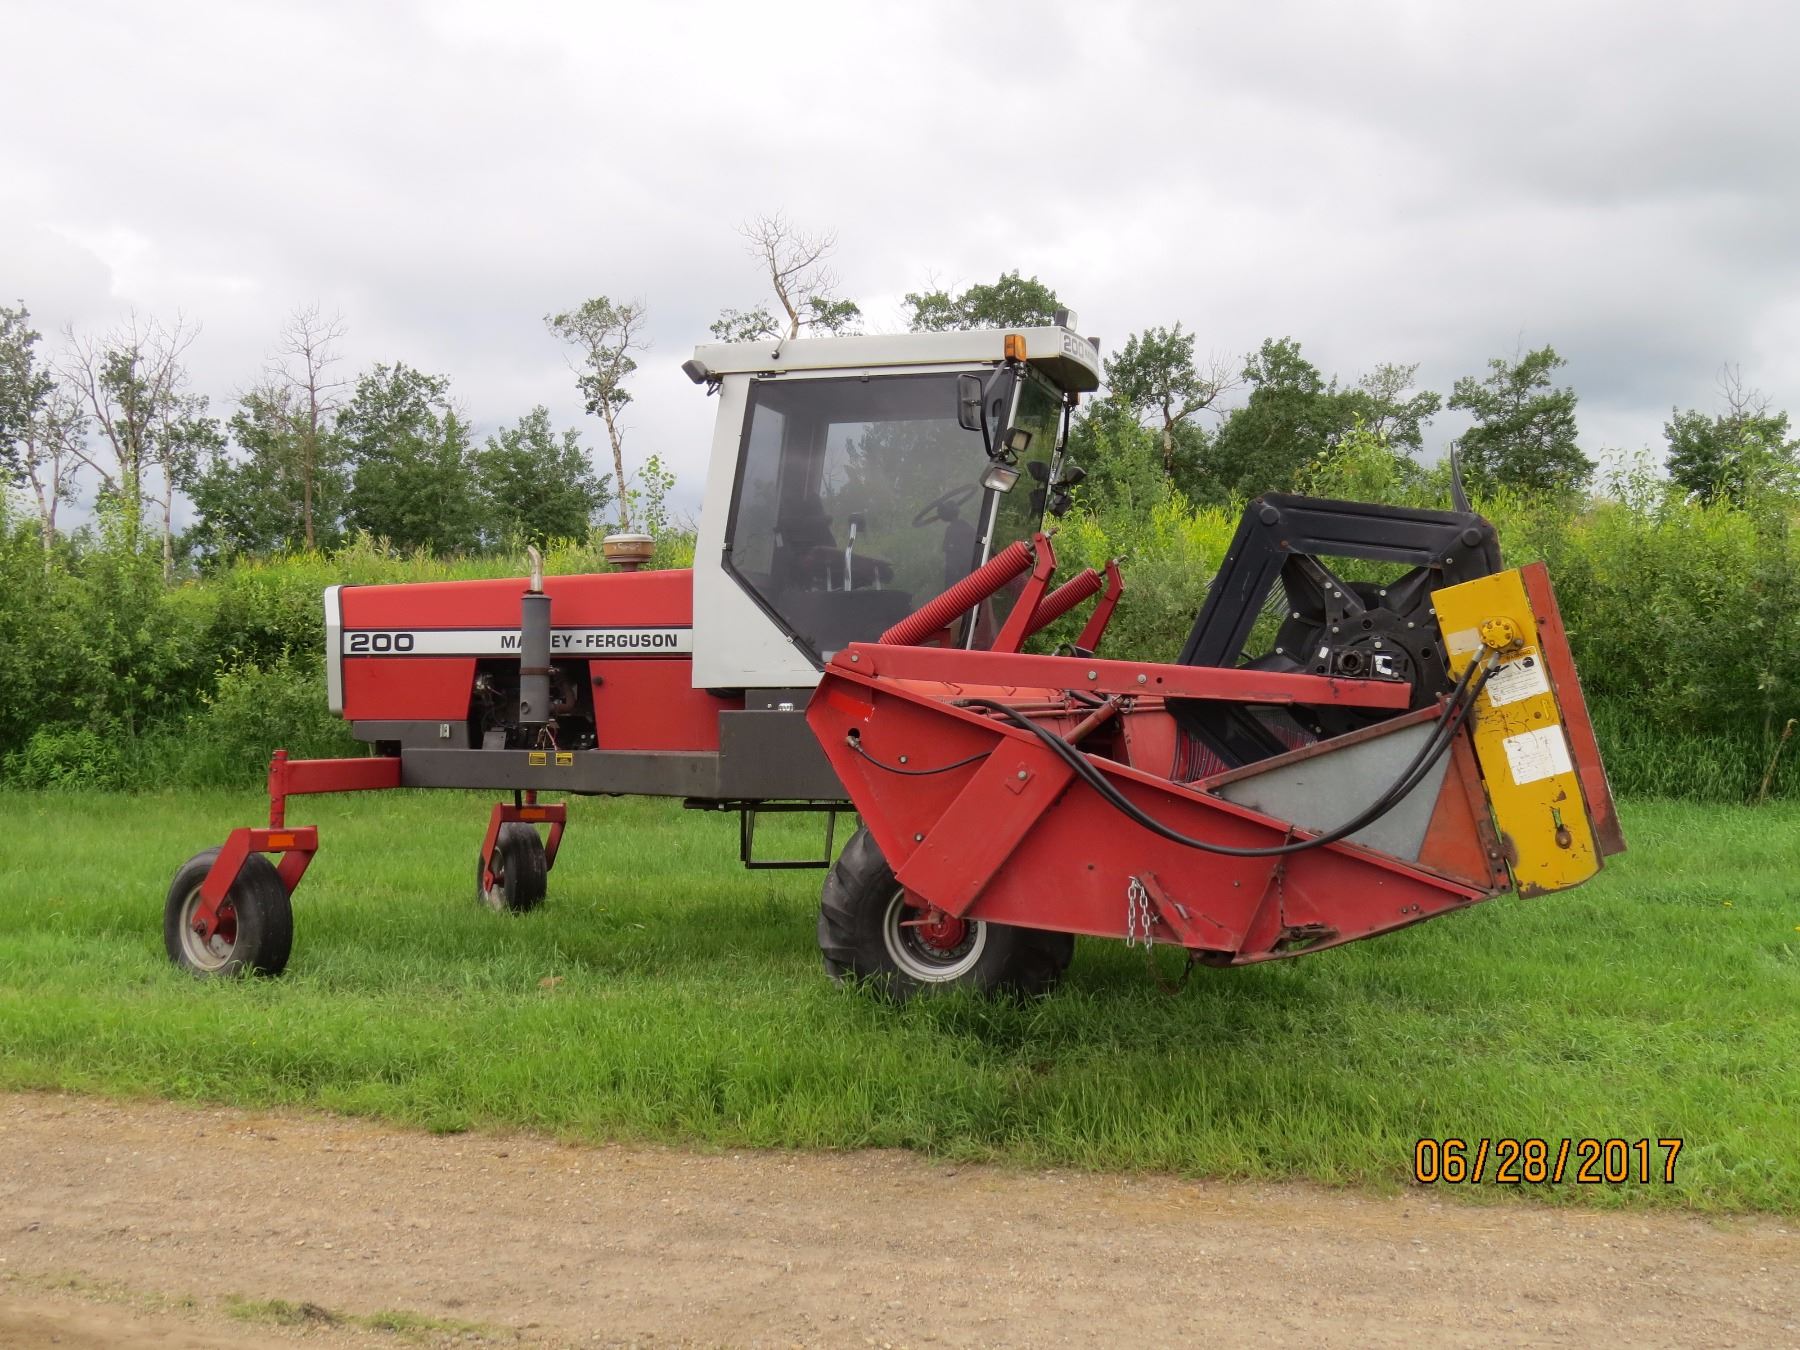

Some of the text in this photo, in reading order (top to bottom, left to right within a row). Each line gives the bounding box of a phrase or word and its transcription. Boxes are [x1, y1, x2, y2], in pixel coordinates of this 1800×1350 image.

[1063, 334, 1084, 358] 200
[350, 633, 414, 652] 200
[501, 634, 677, 649] MEY-FERGUSON
